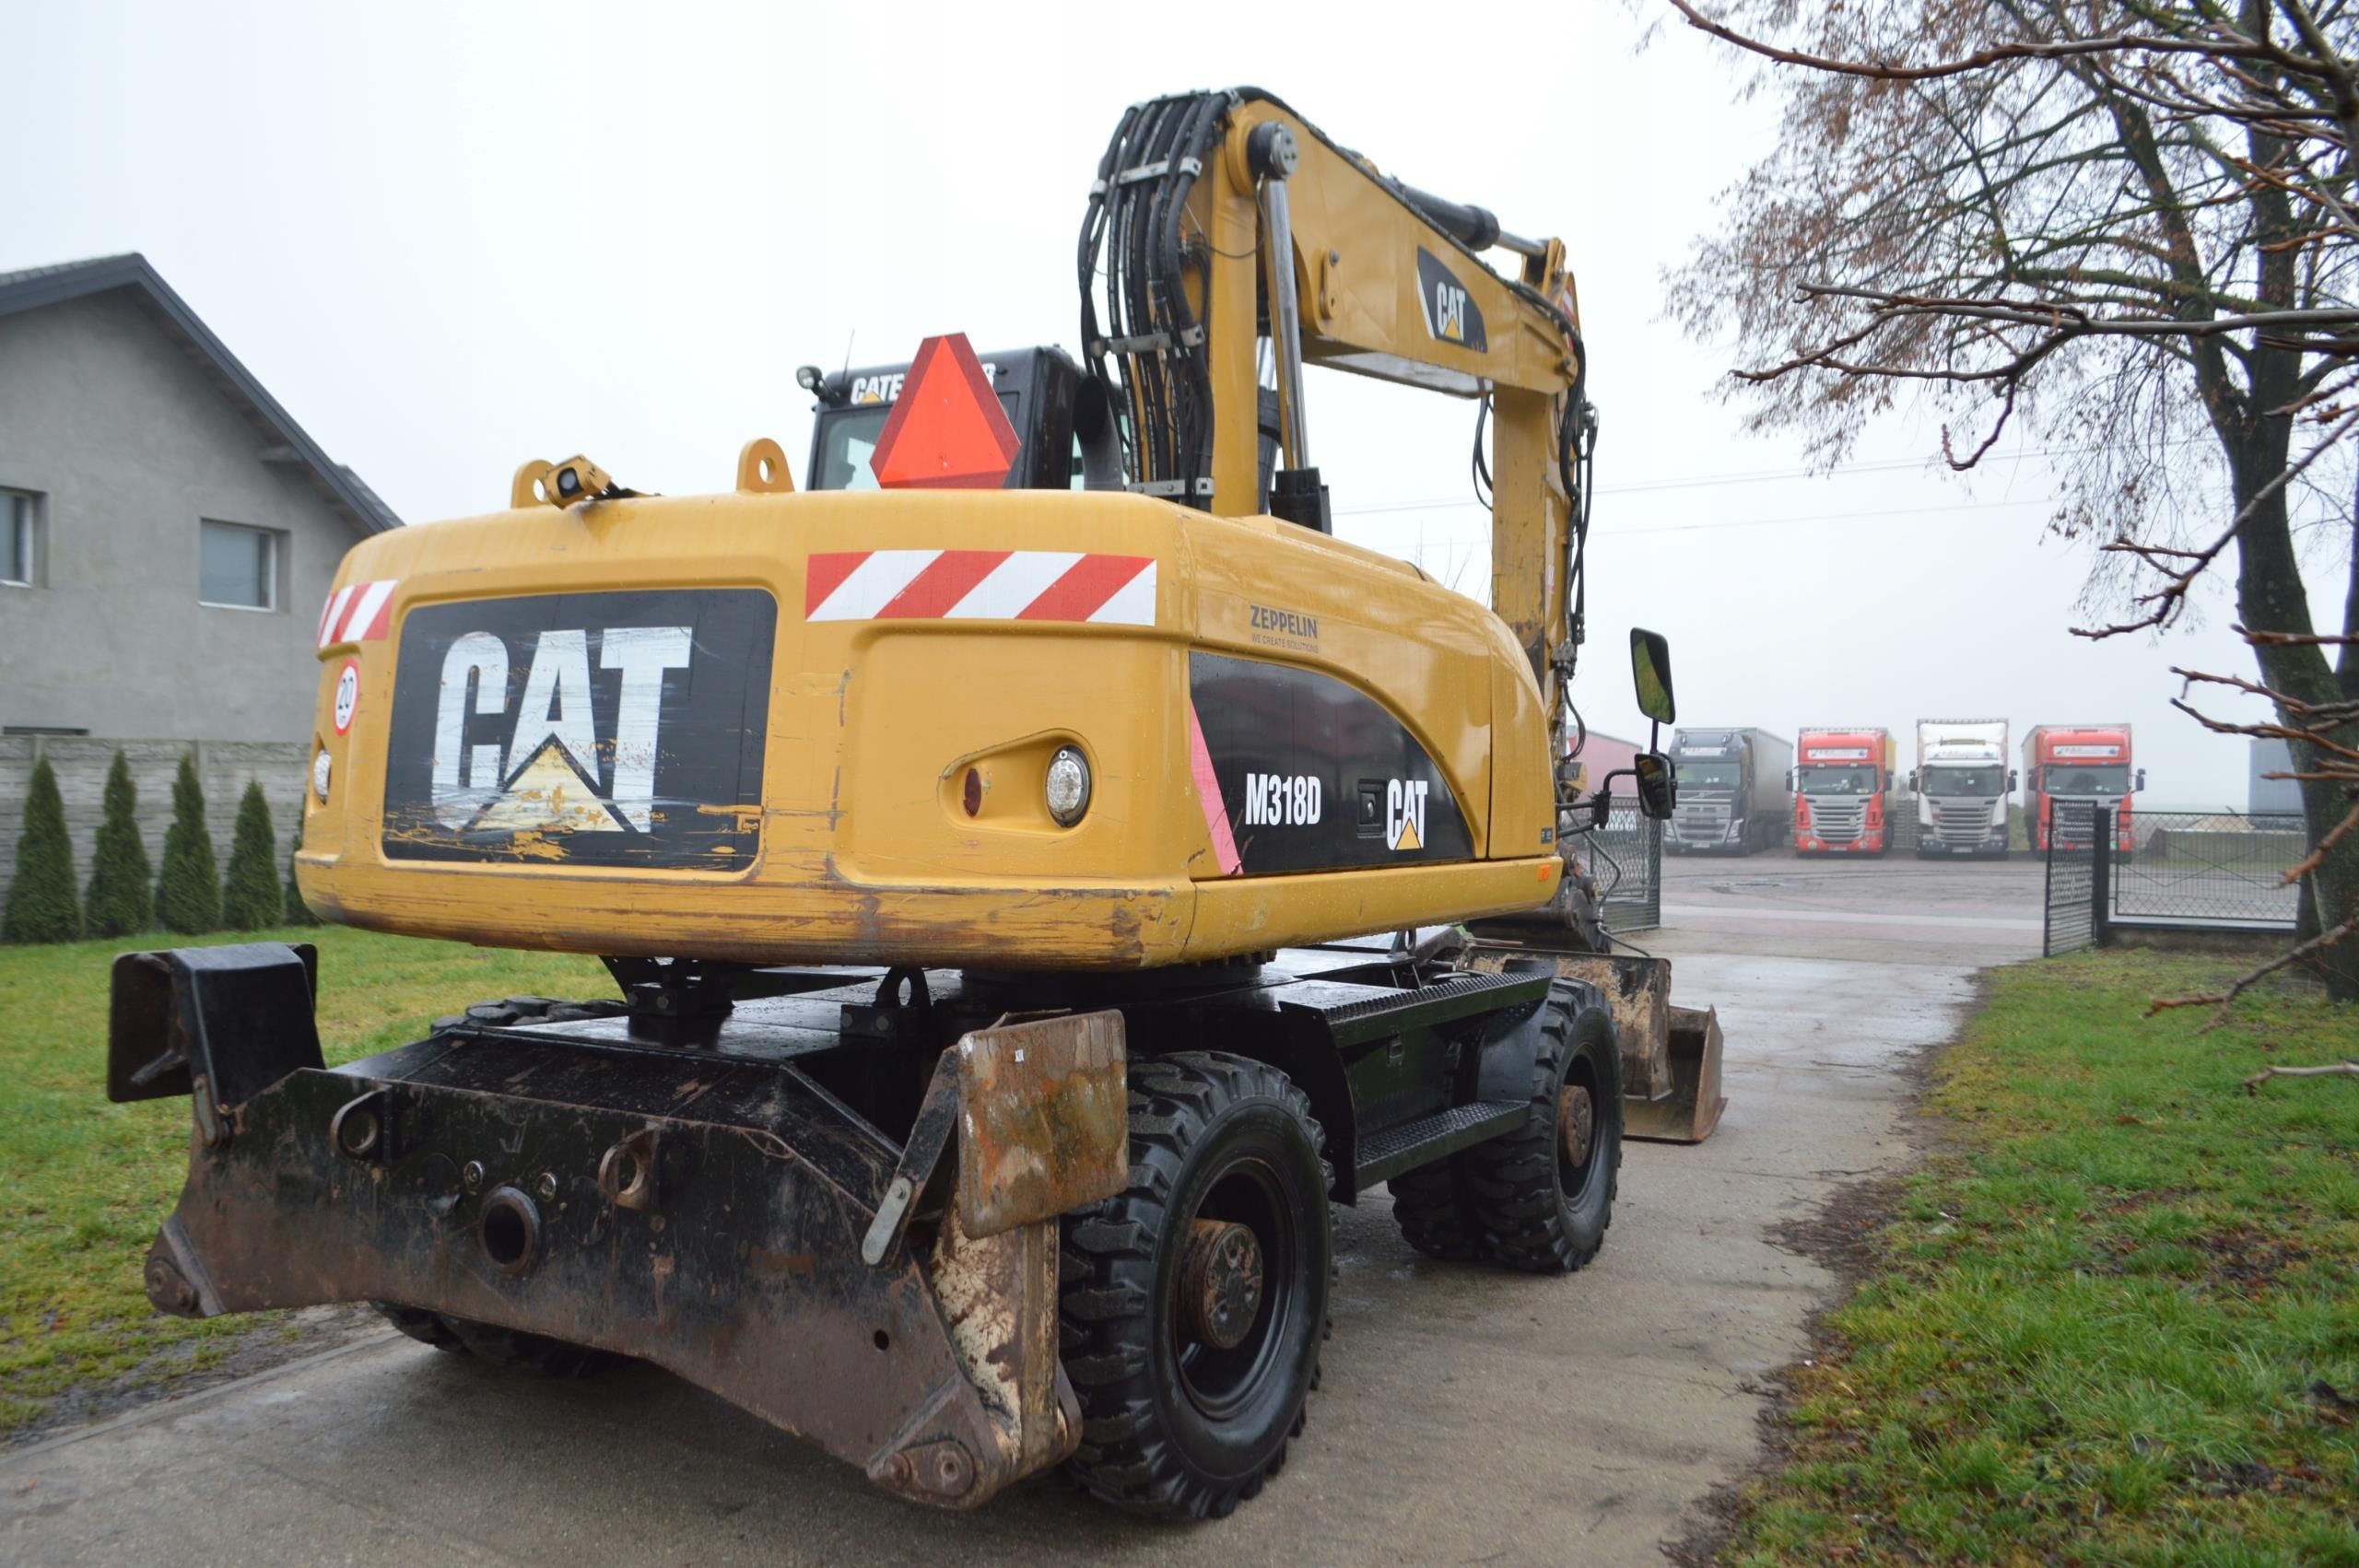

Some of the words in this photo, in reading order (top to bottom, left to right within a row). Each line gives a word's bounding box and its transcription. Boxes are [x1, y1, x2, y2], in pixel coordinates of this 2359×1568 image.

[1437, 281, 1465, 343] CAT
[1250, 604, 1318, 638] ZEPPELIN
[338, 676, 354, 710] 20
[431, 626, 693, 834] CAT
[1245, 773, 1321, 825] M318D
[1387, 778, 1427, 850] CAT
